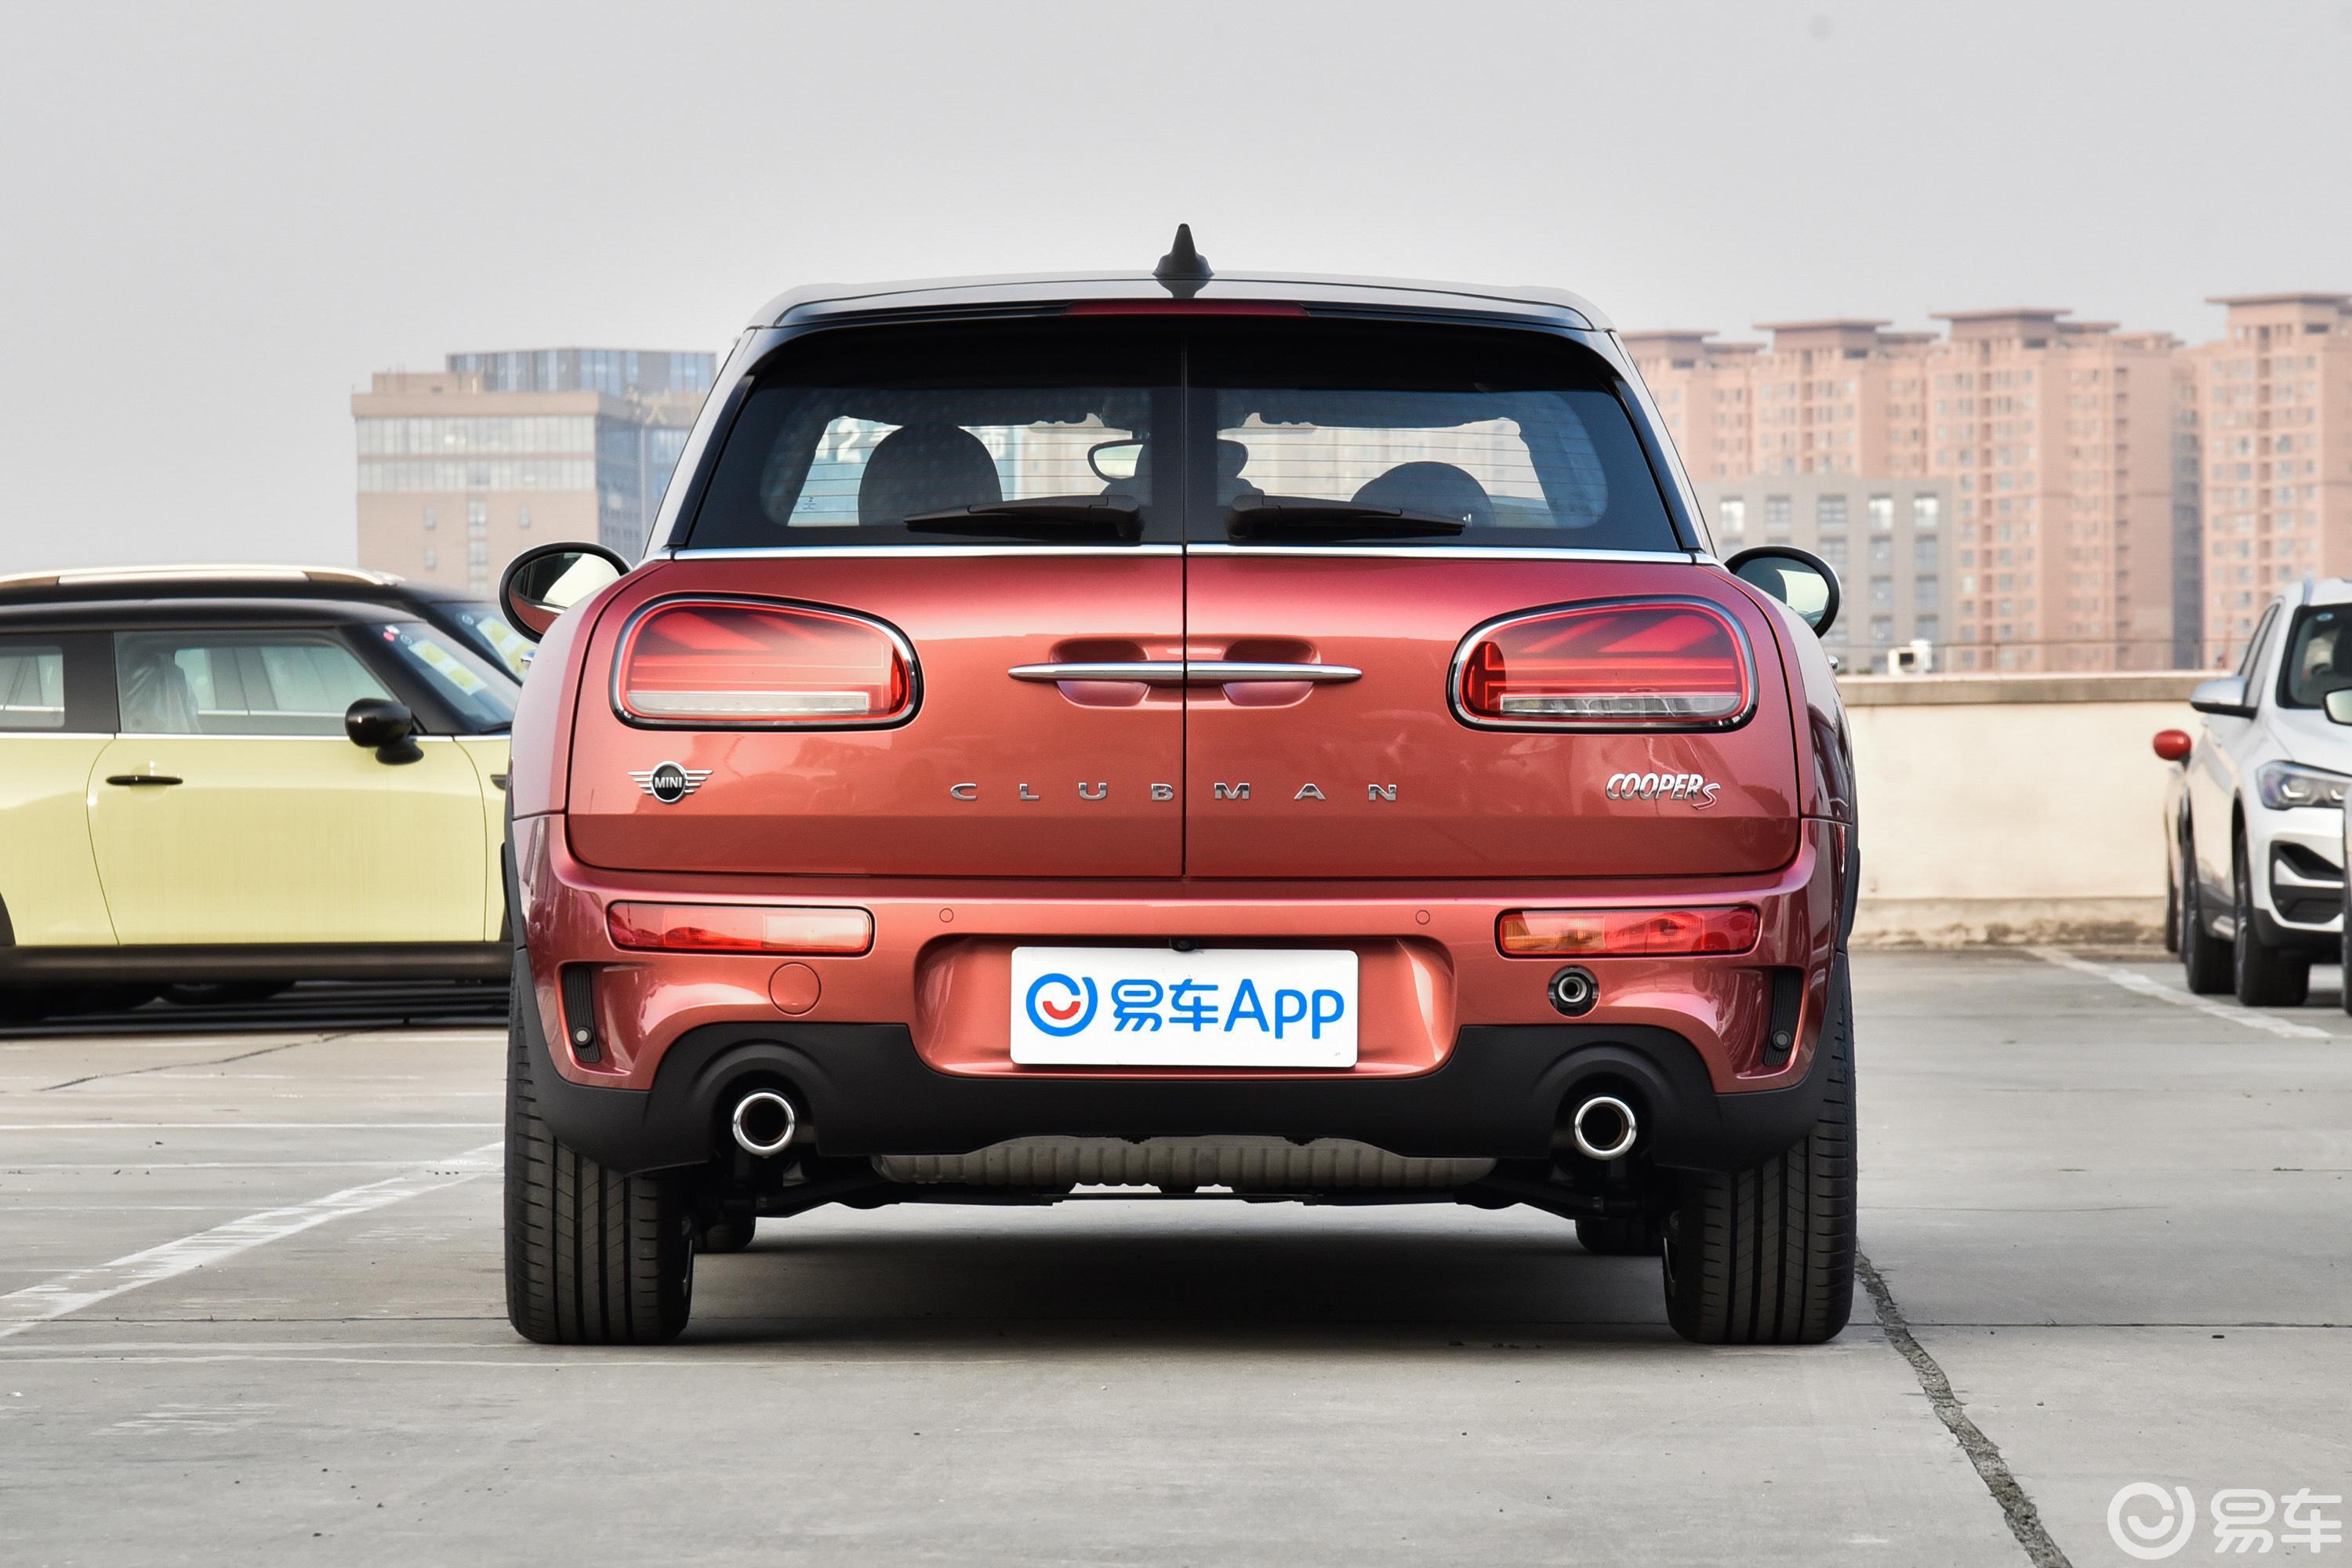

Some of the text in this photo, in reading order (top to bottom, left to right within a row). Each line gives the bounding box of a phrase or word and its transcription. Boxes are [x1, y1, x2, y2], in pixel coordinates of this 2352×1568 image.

[655, 776, 683, 789] MINI
[950, 782, 1397, 801] CLUBMAN
[1111, 978, 1345, 1040] 易车App
